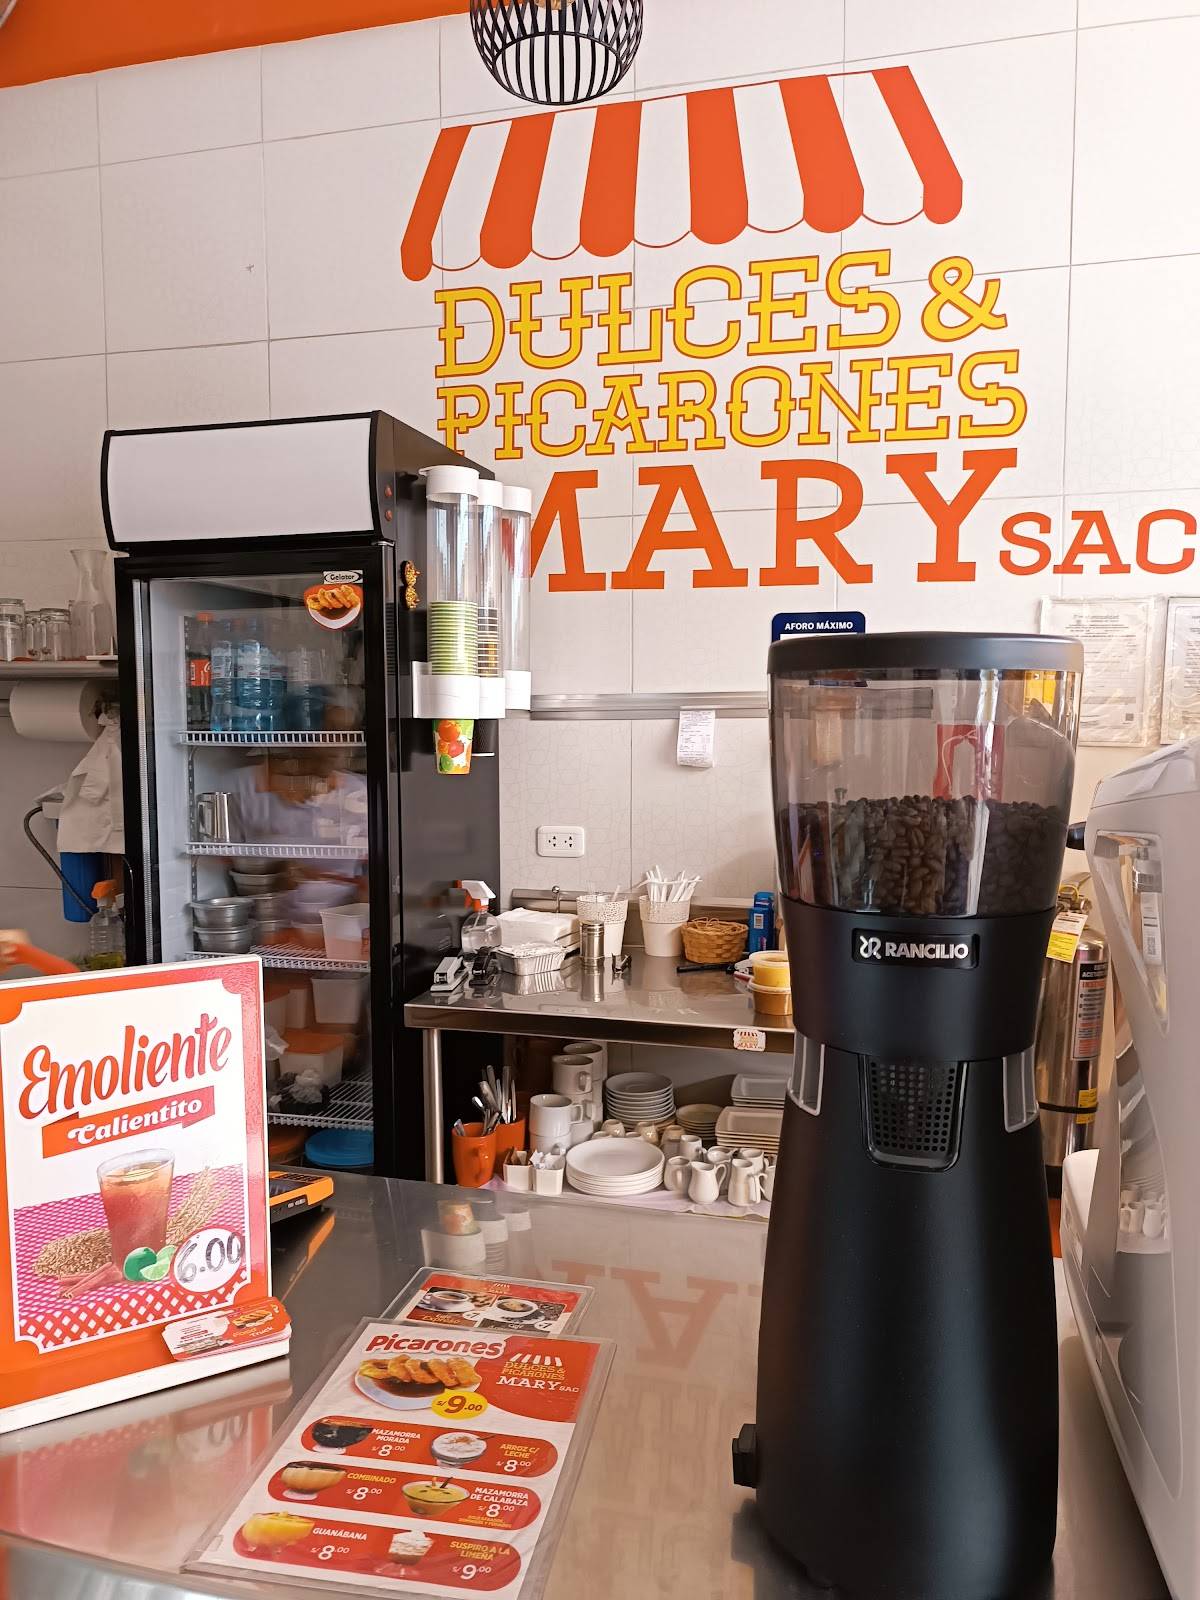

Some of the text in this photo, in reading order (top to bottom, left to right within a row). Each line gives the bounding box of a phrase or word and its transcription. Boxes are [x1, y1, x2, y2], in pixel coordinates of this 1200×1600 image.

[434, 249, 1007, 379] DULCES &
[436, 349, 1027, 459] PICARONES
[999, 508, 1197, 576] SAC
[784, 620, 853, 630] AFORO MÁXIMO
[885, 942, 969, 959] RANCILIO
[18, 1013, 232, 1120] Emoliente
[67, 1098, 202, 1146] Calientito
[177, 1231, 245, 1285] 6.00
[249, 1326, 274, 1337] Truck
[366, 1334, 502, 1356] Picarones
[504, 1361, 554, 1373] DULCES
[496, 1375, 561, 1390] MARY
[371, 1428, 420, 1439] MAZAMORRA
[375, 1435, 410, 1444] MORADA
[500, 1443, 528, 1452] ARROZ
[504, 1450, 530, 1459] LECHE
[347, 1472, 397, 1484] COMBINADO
[470, 1493, 528, 1507] DE CALABAZA
[474, 1486, 529, 1500] MAZAMORRA
[312, 1527, 367, 1540] GUANÁBANA
[450, 1540, 488, 1552] SUSPIRO
